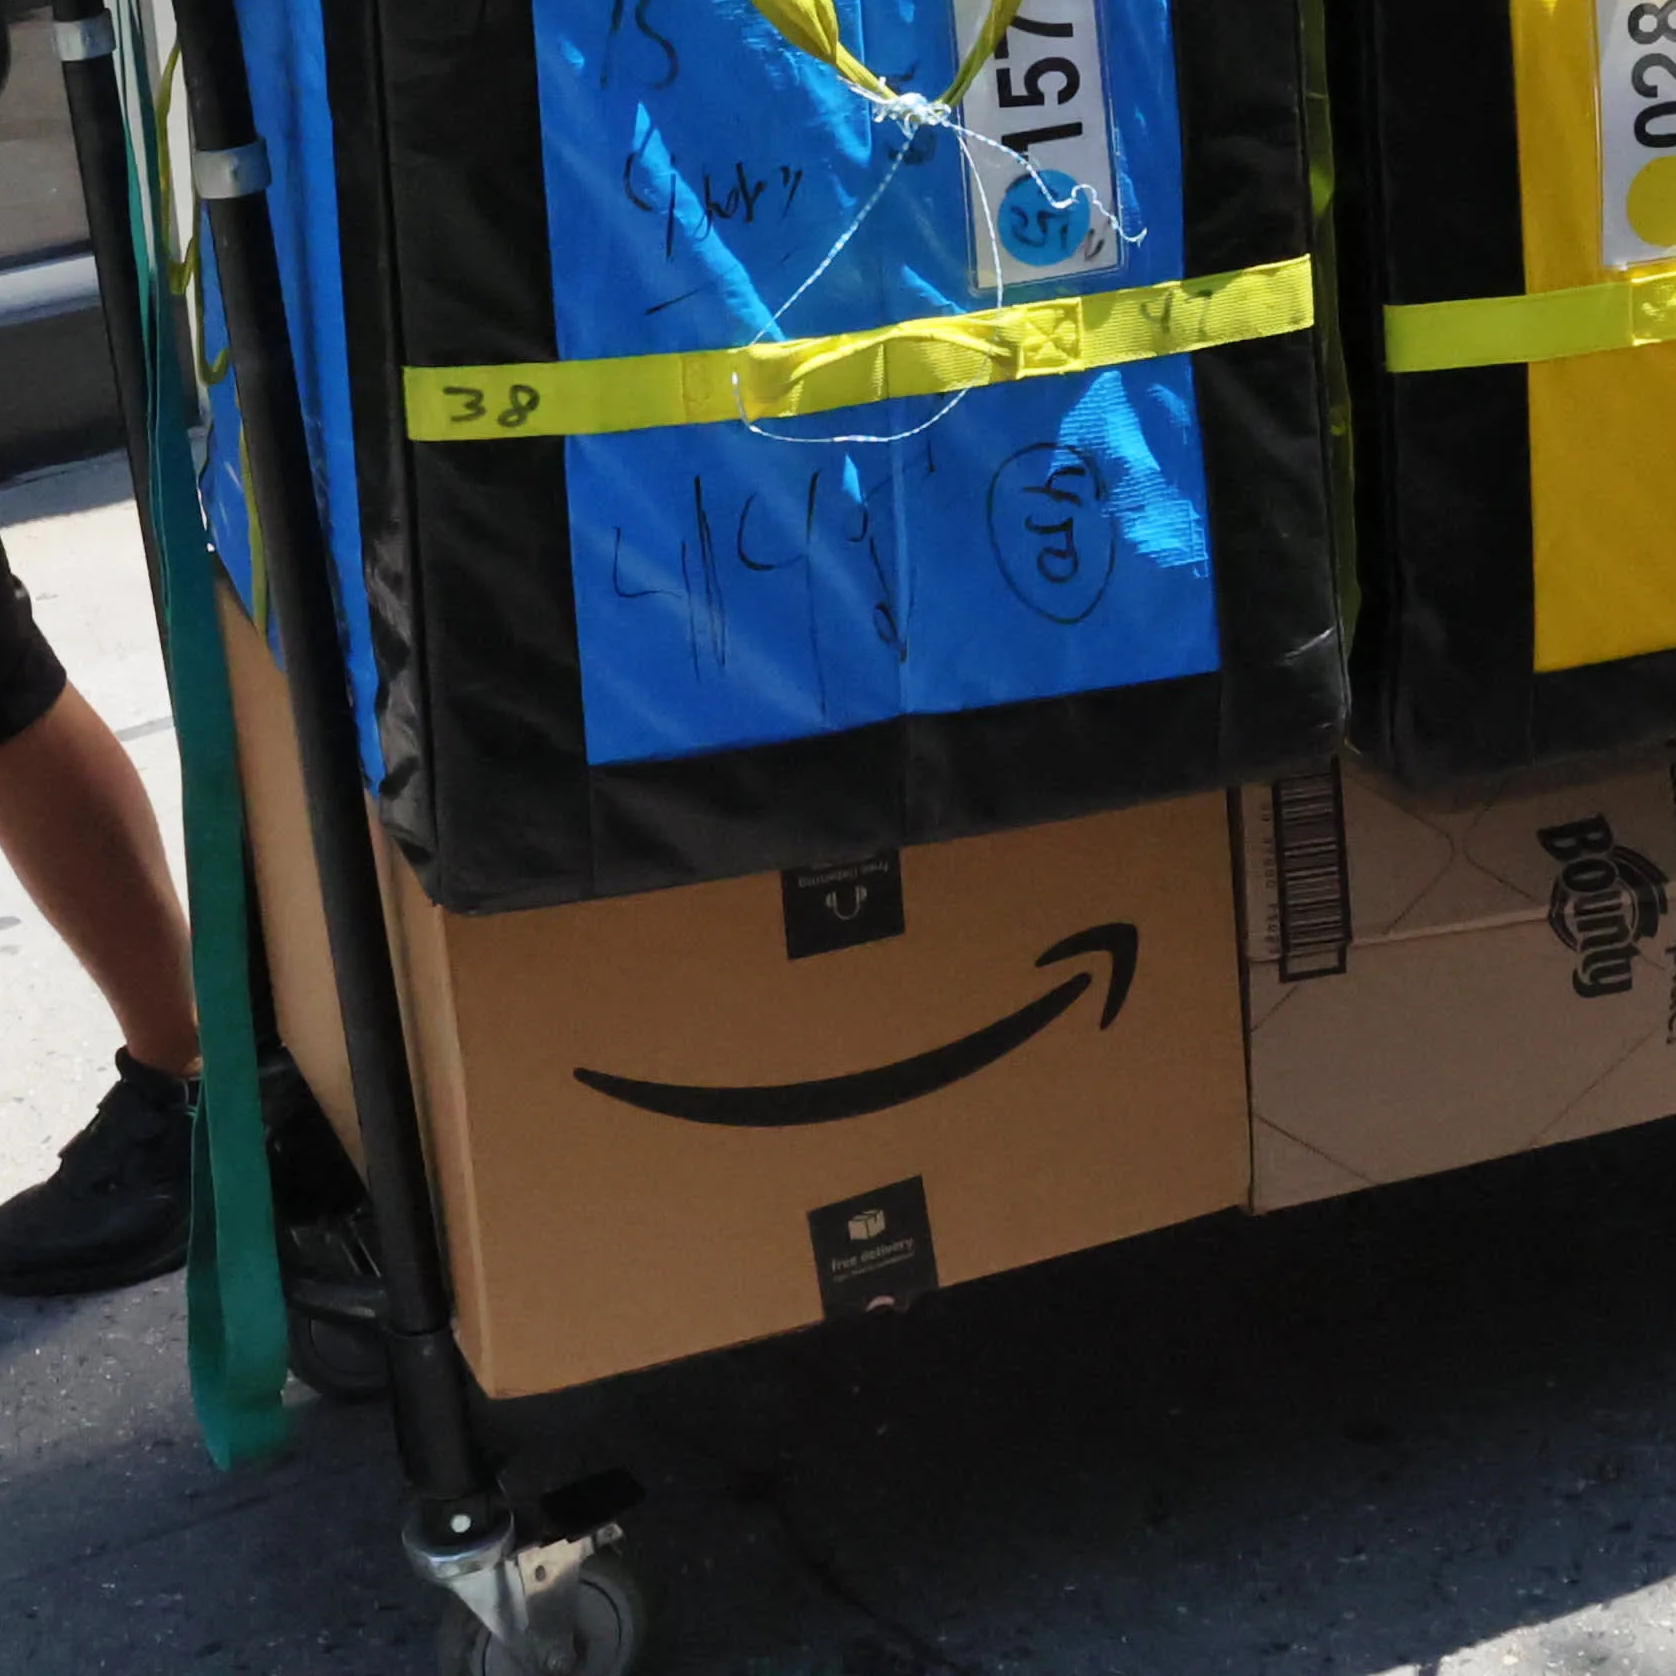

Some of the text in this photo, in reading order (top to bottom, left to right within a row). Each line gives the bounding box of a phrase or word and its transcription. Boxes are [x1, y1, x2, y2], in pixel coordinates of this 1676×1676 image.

[996, 16, 1083, 160] 157
[442, 384, 541, 429] 38
[831, 1236, 915, 1273] free delivery
